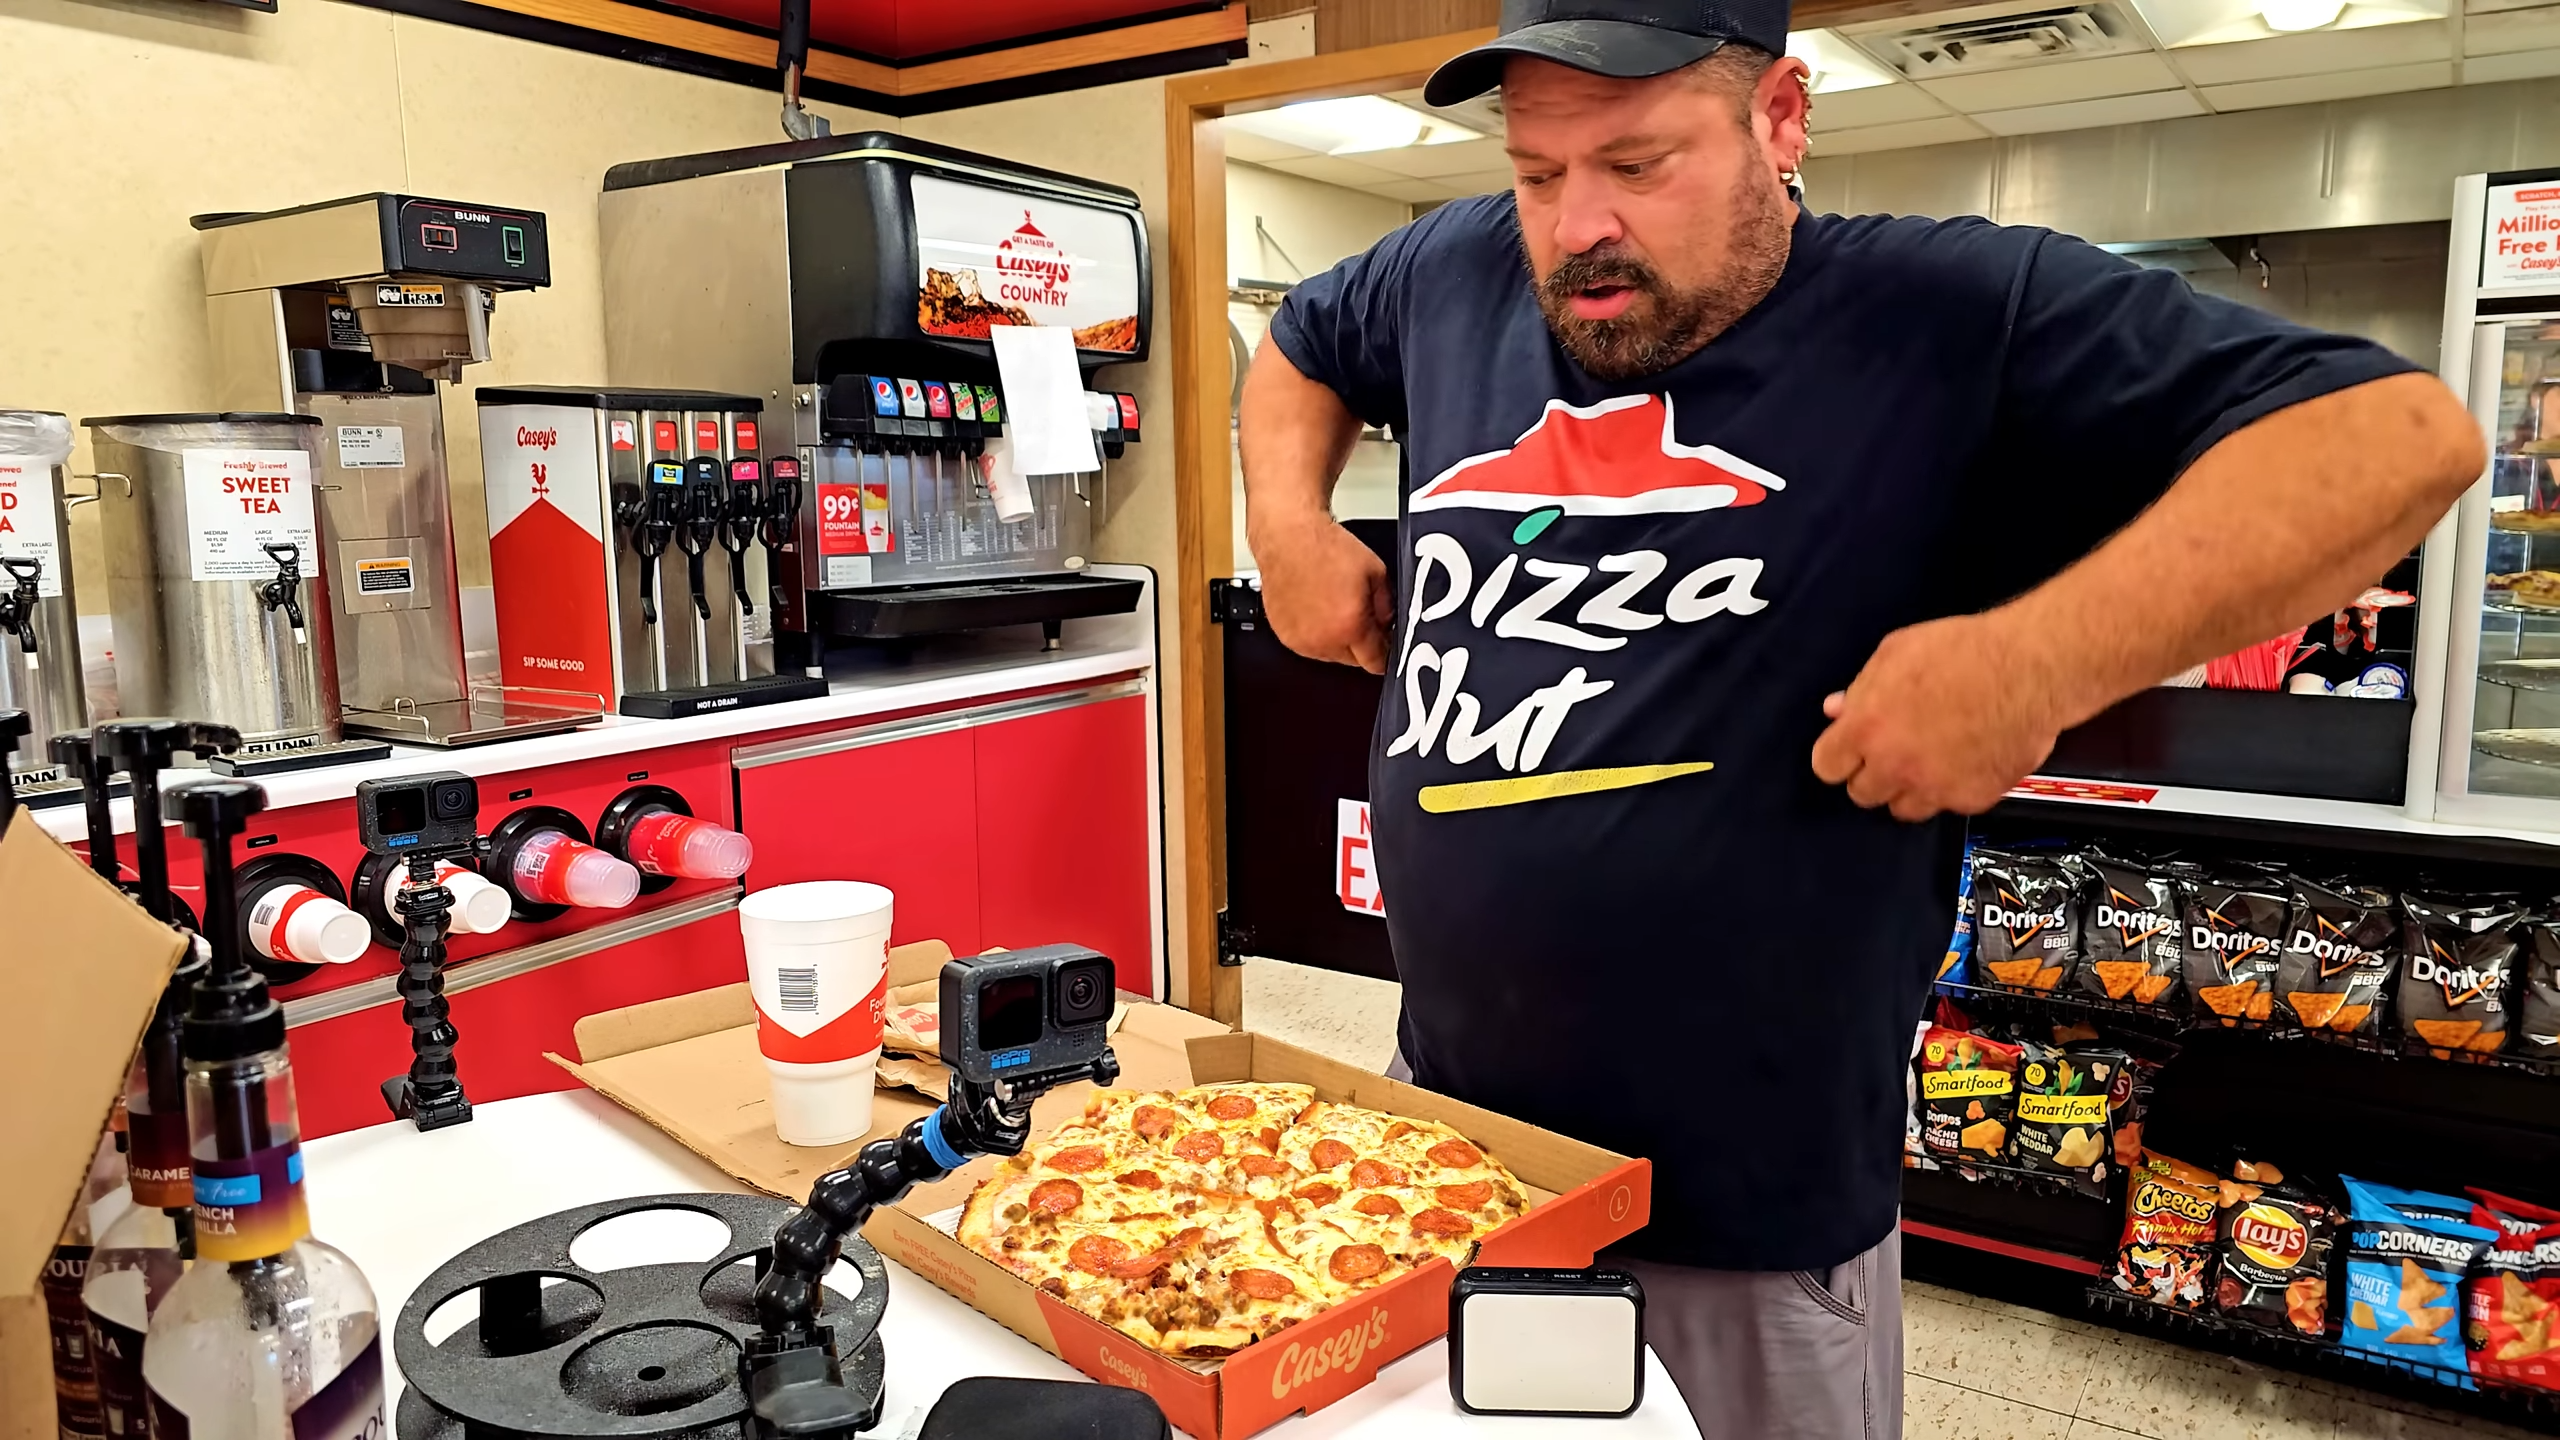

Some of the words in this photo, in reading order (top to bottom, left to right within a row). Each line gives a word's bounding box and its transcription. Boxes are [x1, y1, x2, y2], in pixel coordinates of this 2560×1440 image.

[454, 211, 491, 224] BUNN
[2497, 214, 2560, 235] Millio
[1012, 236, 1023, 244] GET
[1030, 239, 1046, 248] TASTE
[1046, 241, 1054, 249] OF
[2498, 238, 2548, 256] Free
[408, 293, 438, 301] HOT
[1000, 283, 1069, 307] COUNTRY
[517, 425, 557, 451] Casey's
[222, 477, 291, 494] SWEET
[239, 497, 282, 514] TEA
[823, 494, 860, 521] 99¢
[824, 521, 860, 531] FOUNTAIN
[523, 656, 535, 667] SIP
[536, 658, 559, 670] SOME
[559, 660, 585, 671] GOOD
[697, 701, 711, 710] NOT
[718, 697, 738, 707] DRAIN
[10, 769, 59, 786] UNN
[1983, 904, 2065, 929] Doritos
[2097, 905, 2181, 937] Doritos
[2192, 926, 2282, 955] Doritos
[2293, 929, 2385, 967] Doritos
[2412, 955, 2510, 990] Doritos
[991, 1049, 1030, 1060] GoPro
[1931, 1045, 1941, 1054] 70
[2030, 1066, 2041, 1076] 70
[1926, 1074, 2004, 1094] Smartfood
[1926, 1109, 1961, 1126] Doritos
[2021, 1098, 2101, 1119] Smartfood
[1925, 1133, 1959, 1148] CHEESE
[2021, 1123, 2049, 1143] WHITE
[131, 1166, 190, 1181] CARAME
[2136, 1184, 2212, 1220] Cheetos
[197, 1206, 234, 1220] ENCH
[200, 1222, 237, 1235] ILLA
[2180, 1222, 2205, 1236] Hot
[2240, 1217, 2303, 1255] Lay's
[2352, 1230, 2474, 1260] POPCORNERS
[893, 1229, 910, 1247] Earn
[910, 1239, 930, 1258] FREE
[930, 1251, 958, 1274] Casey's
[959, 1266, 977, 1286] Pizza
[901, 1250, 915, 1262] with
[917, 1257, 944, 1280] Casey's
[944, 1273, 976, 1299] Rewards
[2351, 1272, 2393, 1297] WHITE
[2349, 1287, 2389, 1306] CHEDDAR
[1271, 1305, 1389, 1400] Casey's
[1099, 1345, 1148, 1388] Casey's
